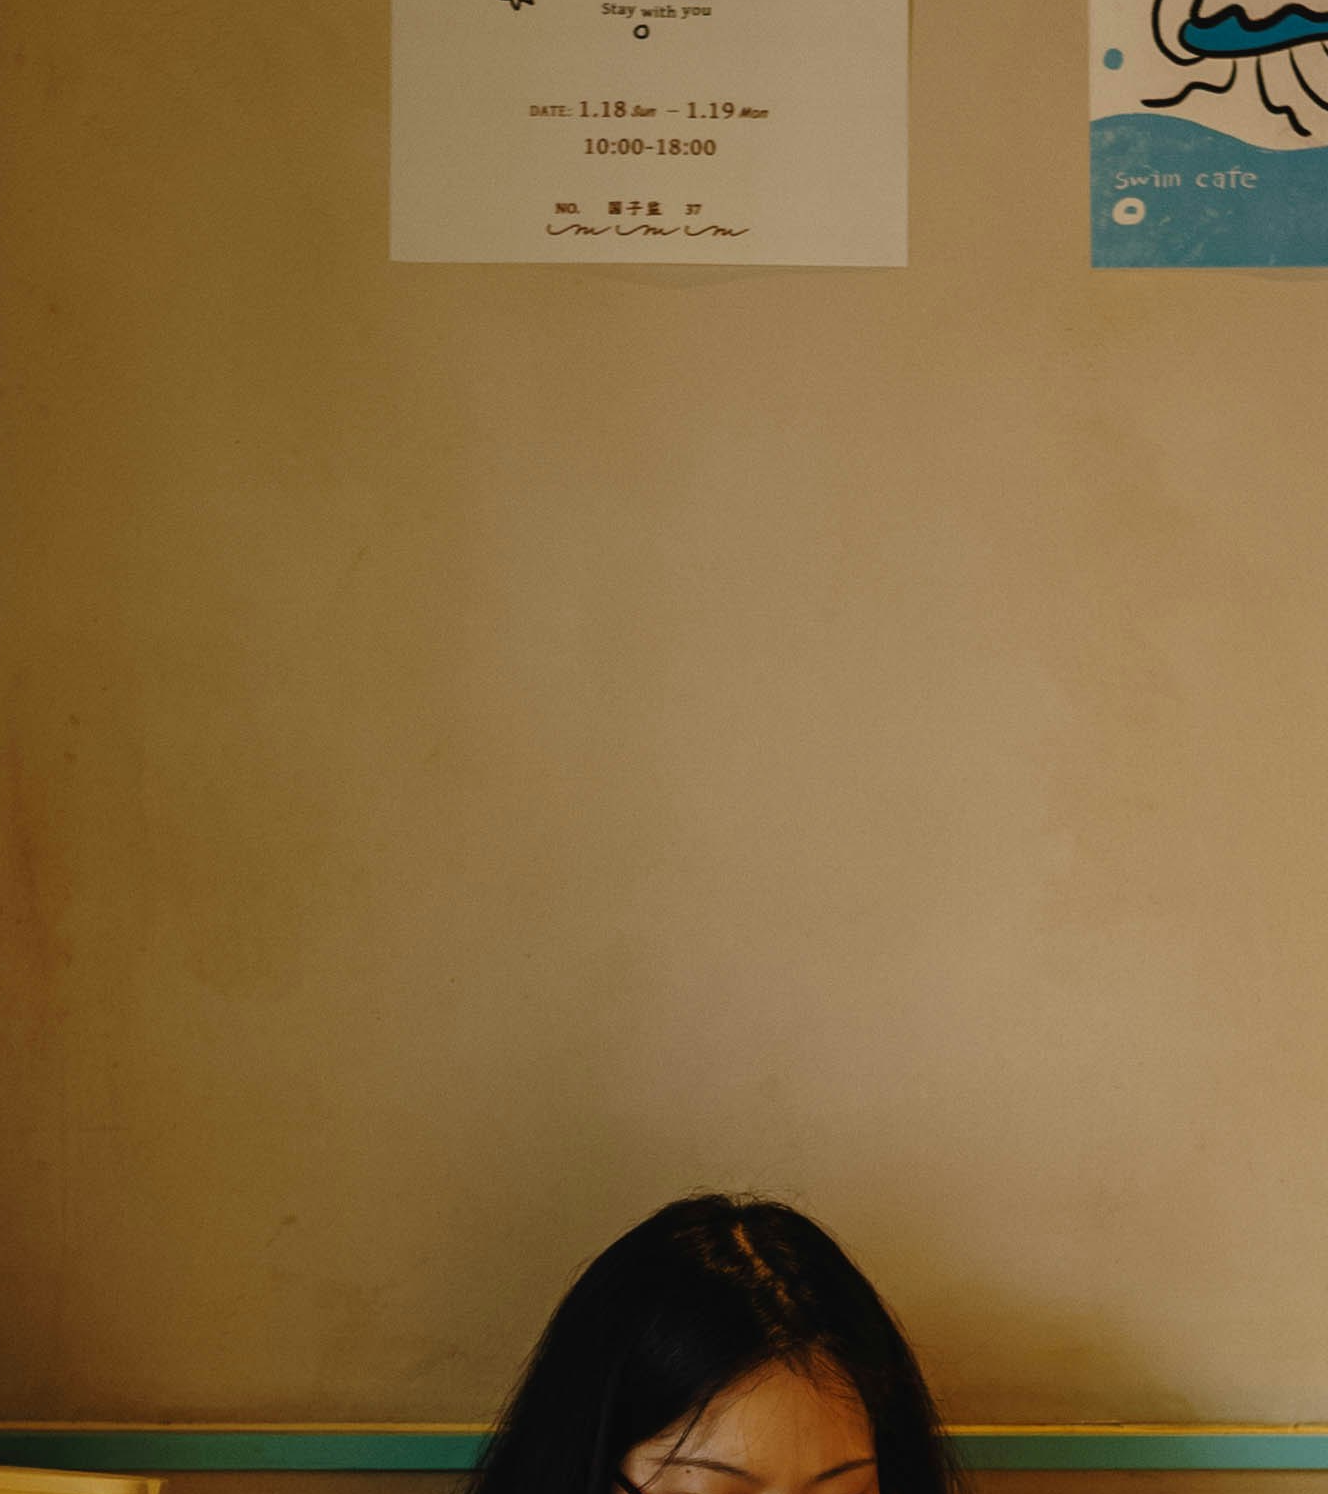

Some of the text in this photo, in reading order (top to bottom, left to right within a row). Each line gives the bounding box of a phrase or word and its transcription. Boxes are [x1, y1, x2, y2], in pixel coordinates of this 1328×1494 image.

[601, 2, 712, 20] Stay with you
[529, 105, 572, 118] DATE:
[579, 100, 627, 119] 1.18
[631, 105, 658, 118] Sun
[686, 101, 735, 120] 1.19
[738, 107, 770, 120] Mon
[583, 137, 718, 156] 10:00-18:00
[1114, 165, 1259, 191] Swim cafe
[554, 202, 581, 215] NO.
[684, 203, 703, 216] 37
